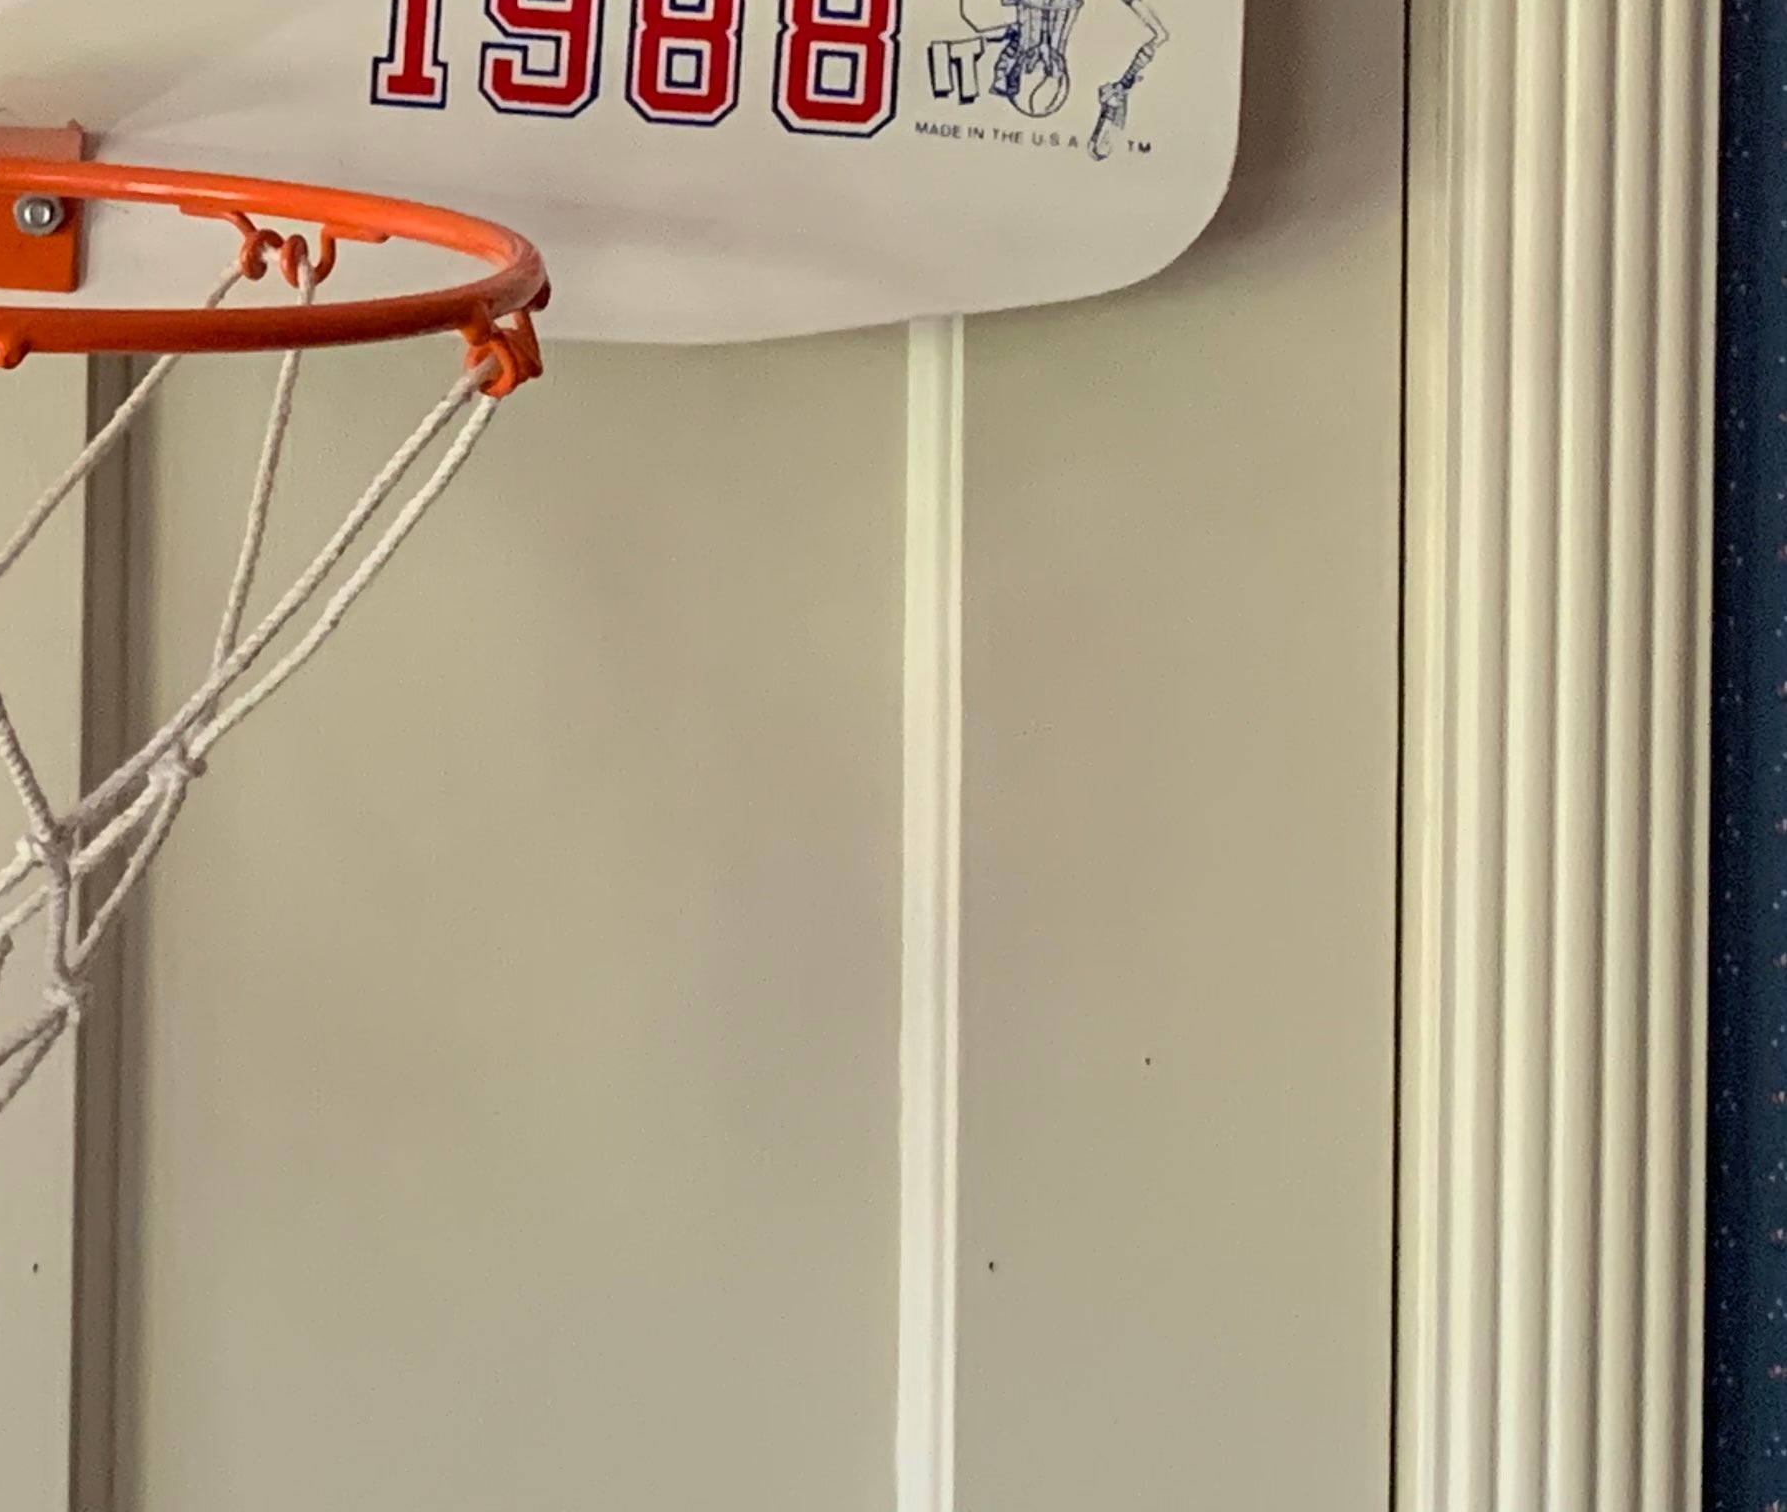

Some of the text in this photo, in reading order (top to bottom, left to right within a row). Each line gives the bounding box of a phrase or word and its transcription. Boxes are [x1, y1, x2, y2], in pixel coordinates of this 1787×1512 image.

[927, 37, 985, 105] IT
[915, 121, 961, 139] MADE
[968, 126, 985, 140] IN
[992, 128, 1024, 145] THE
[1127, 140, 1152, 154] TM
